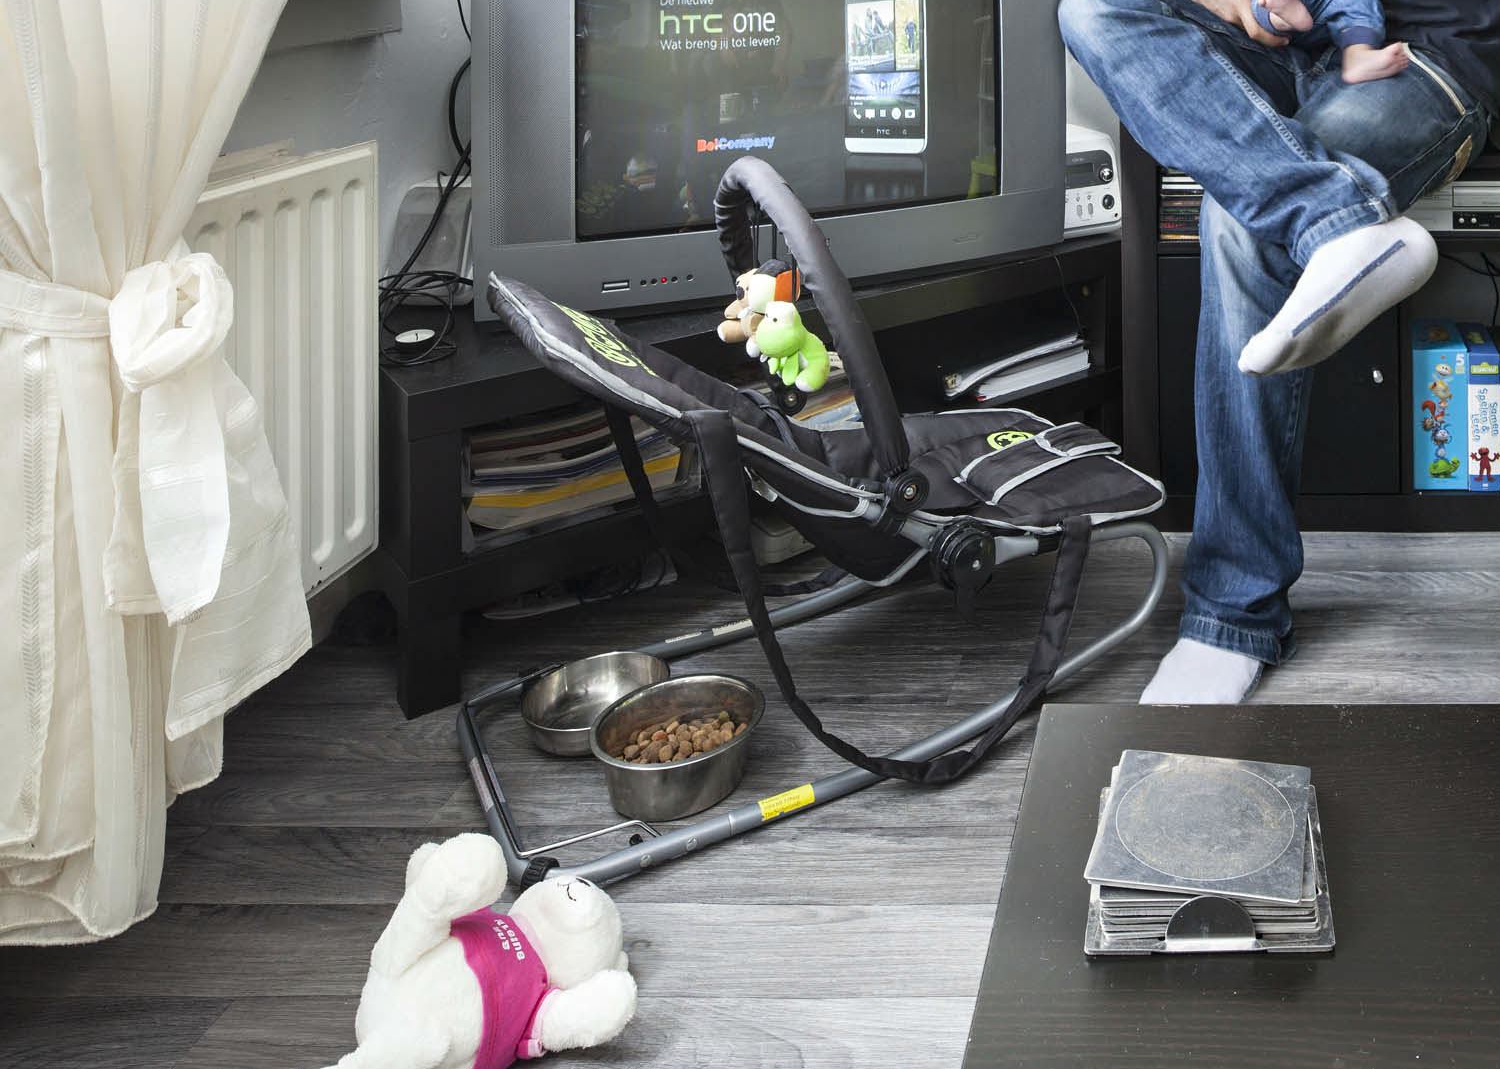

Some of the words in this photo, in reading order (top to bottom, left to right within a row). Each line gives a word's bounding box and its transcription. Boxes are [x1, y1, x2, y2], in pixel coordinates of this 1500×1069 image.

[733, 11, 776, 33] one
[660, 39, 682, 50] Wat
[685, 38, 717, 51] breng
[720, 38, 729, 50] jij
[731, 36, 747, 48] tot
[749, 35, 781, 48] leven?
[1476, 387, 1488, 423] Spelen
[1490, 401, 1500, 436] Samen
[1471, 413, 1481, 441] Leren
